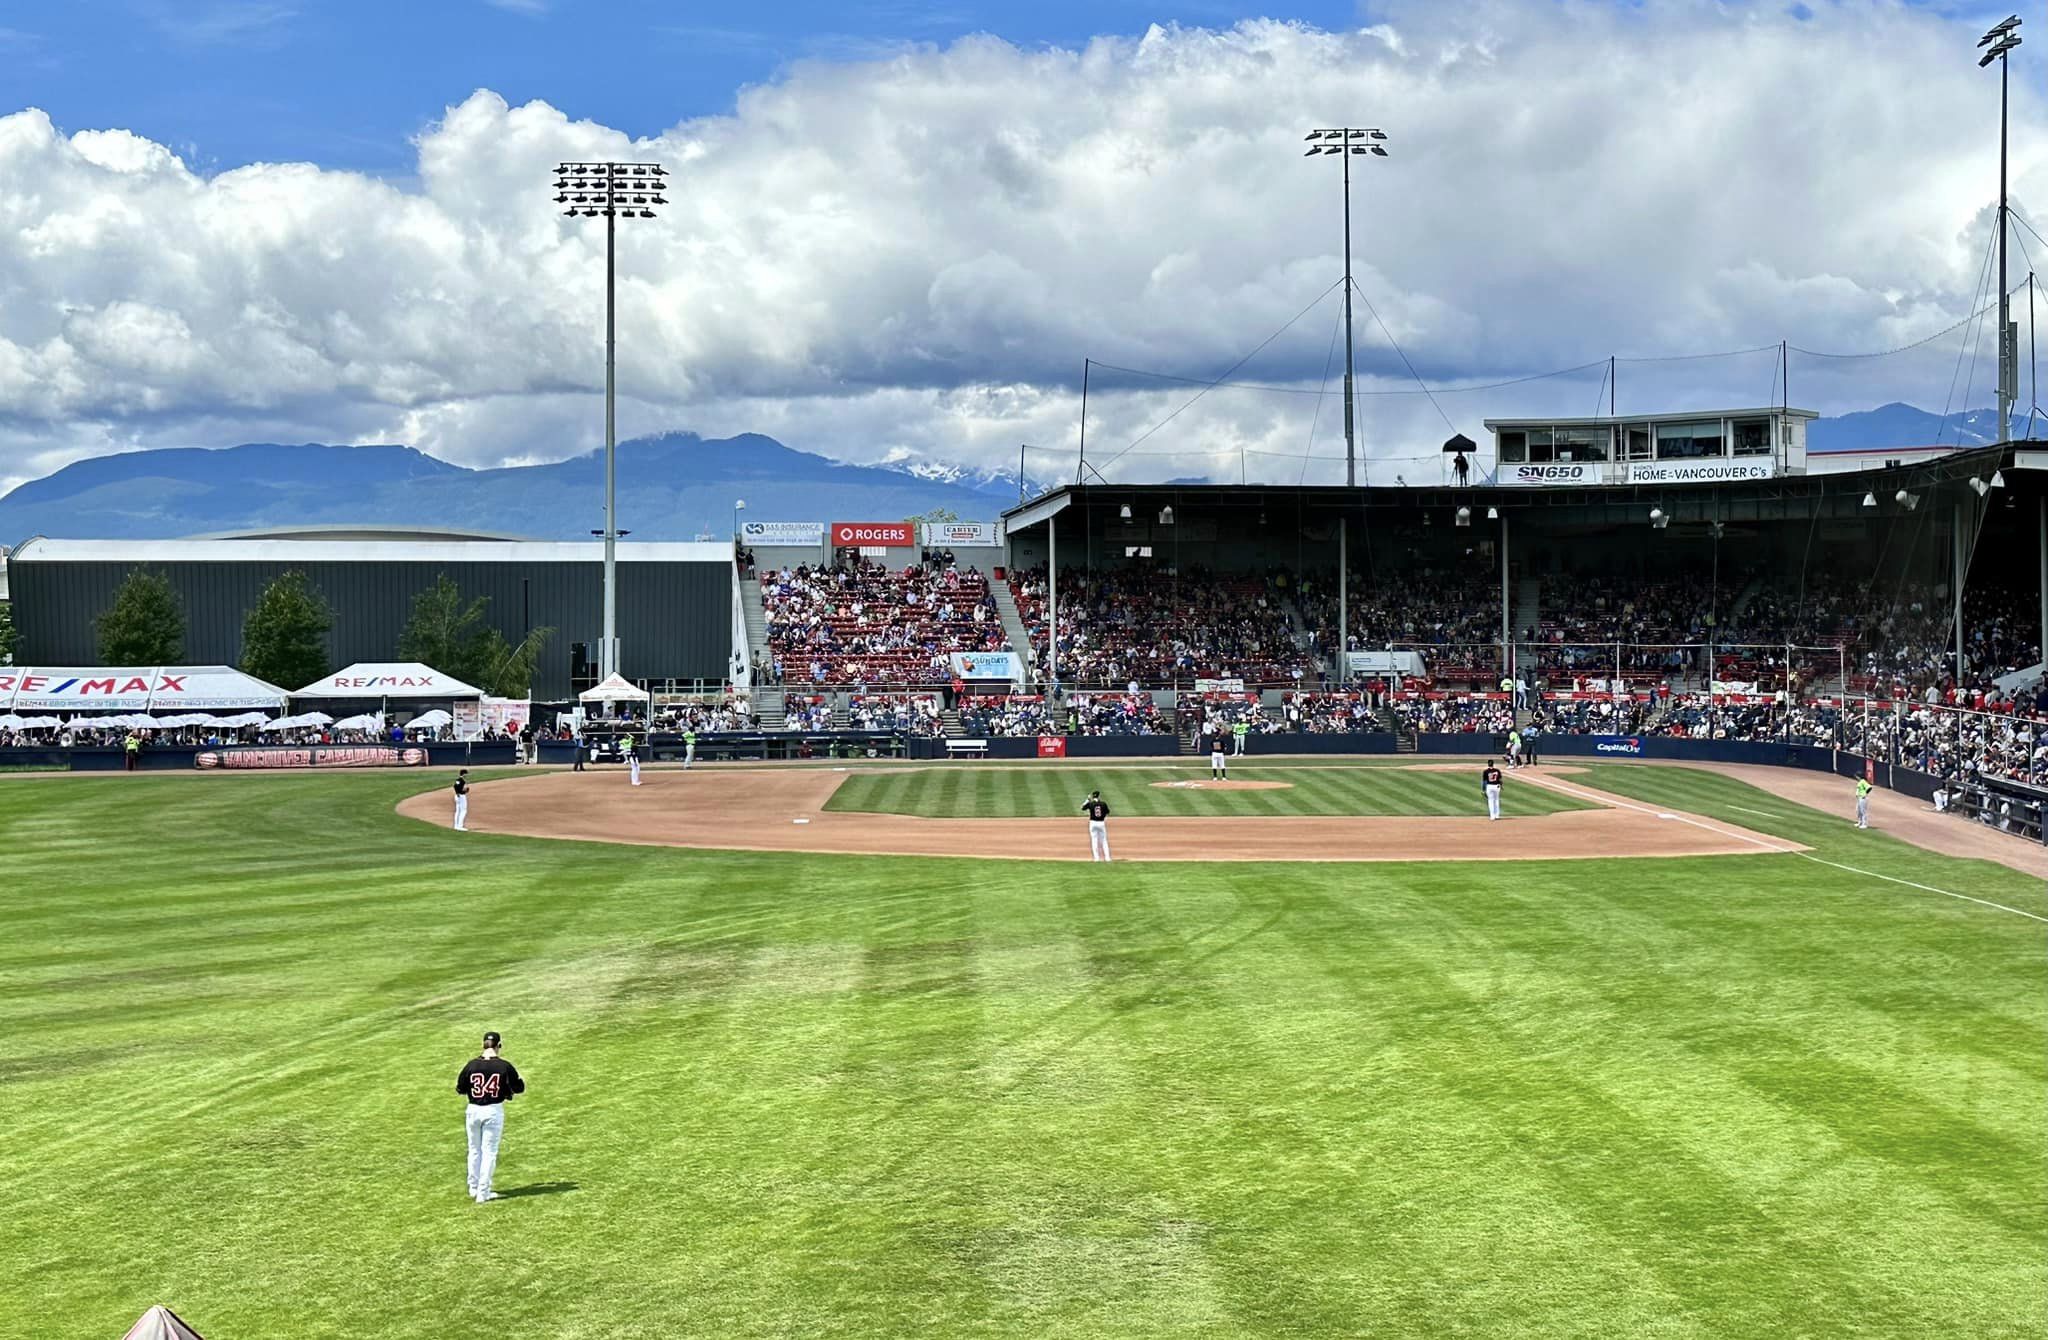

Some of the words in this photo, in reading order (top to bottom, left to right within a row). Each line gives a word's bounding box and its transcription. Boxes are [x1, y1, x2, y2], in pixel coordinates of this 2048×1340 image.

[1517, 466, 1583, 478] SN650
[1633, 470, 1667, 480] HOME
[1675, 467, 1747, 479] VANCOUVER
[1750, 467, 1767, 478] C's
[855, 529, 905, 540] ROGERS
[334, 677, 432, 688] RE/MAX
[223, 751, 310, 767] VANCOUVER
[315, 748, 398, 764] CANADIANS
[470, 1073, 500, 1098] 34
